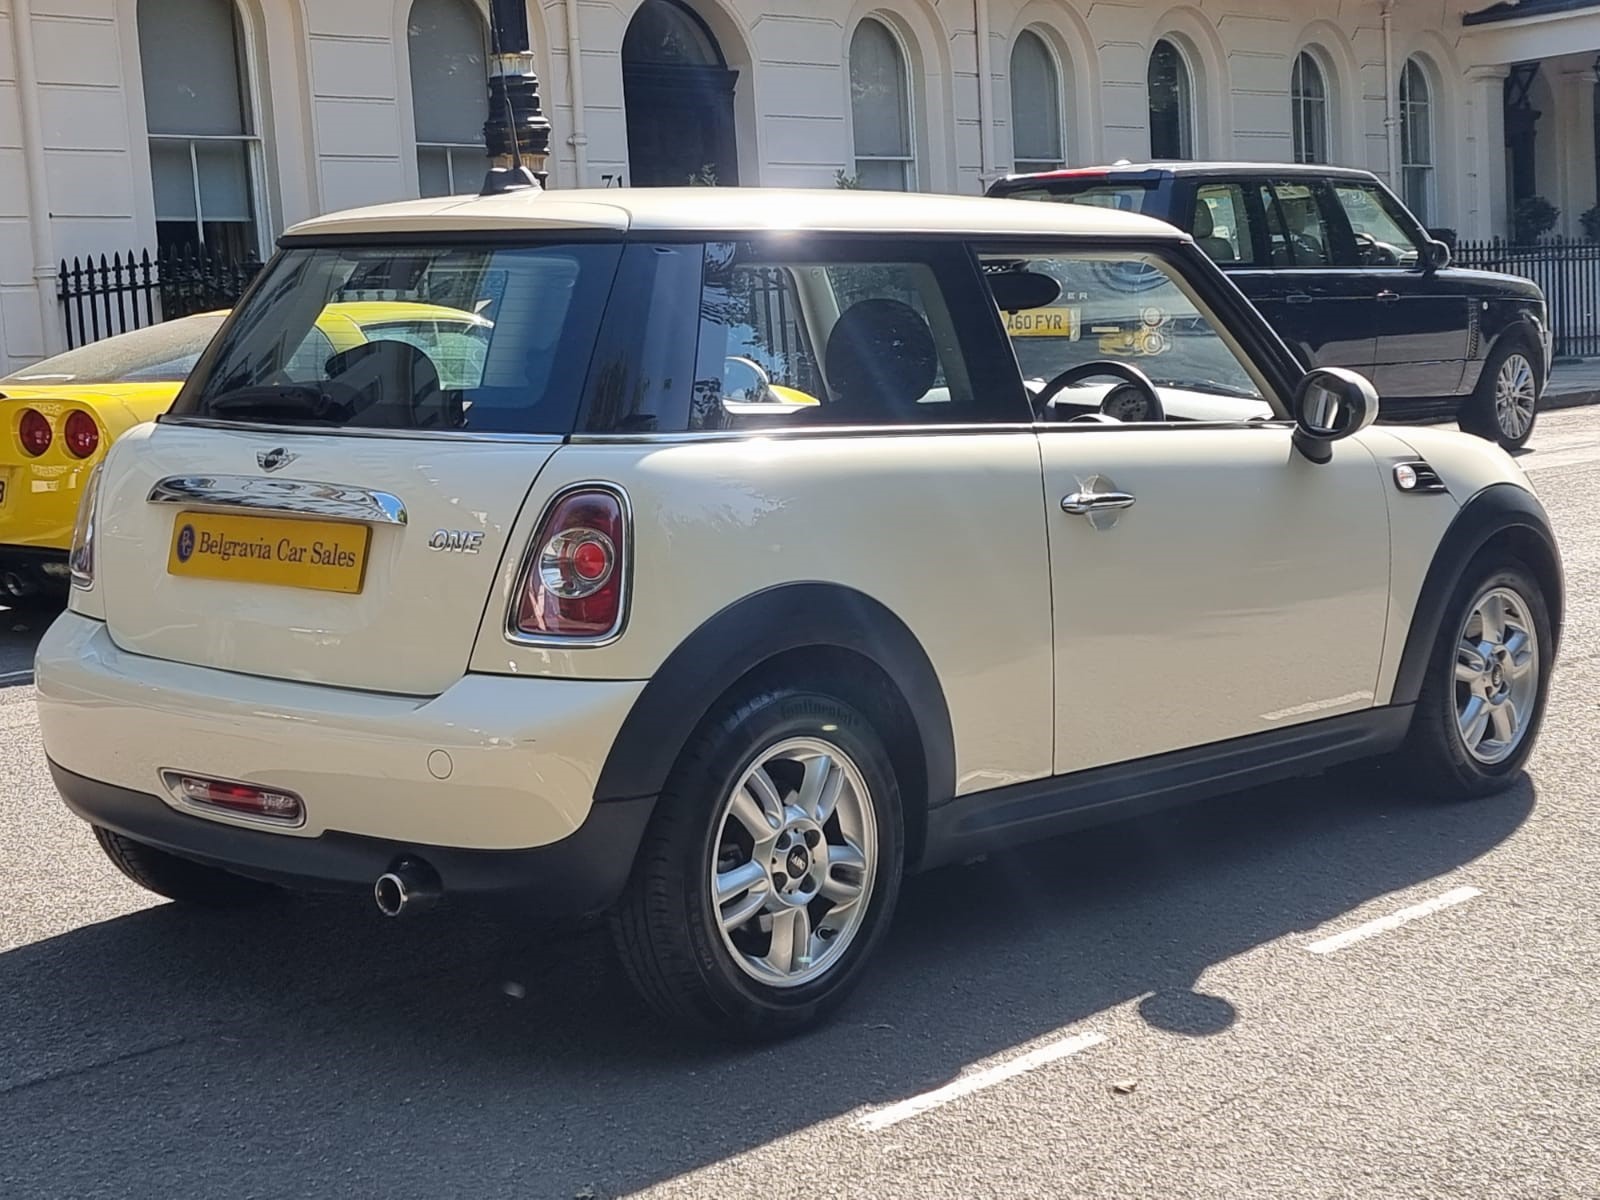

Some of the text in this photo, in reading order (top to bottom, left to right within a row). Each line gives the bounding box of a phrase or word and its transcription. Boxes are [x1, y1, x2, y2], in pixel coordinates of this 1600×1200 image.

[601, 175, 622, 188] 71
[1035, 314, 1063, 330] FYR
[198, 531, 356, 568] Belgravia Car Sales
[428, 528, 486, 554] ONE
